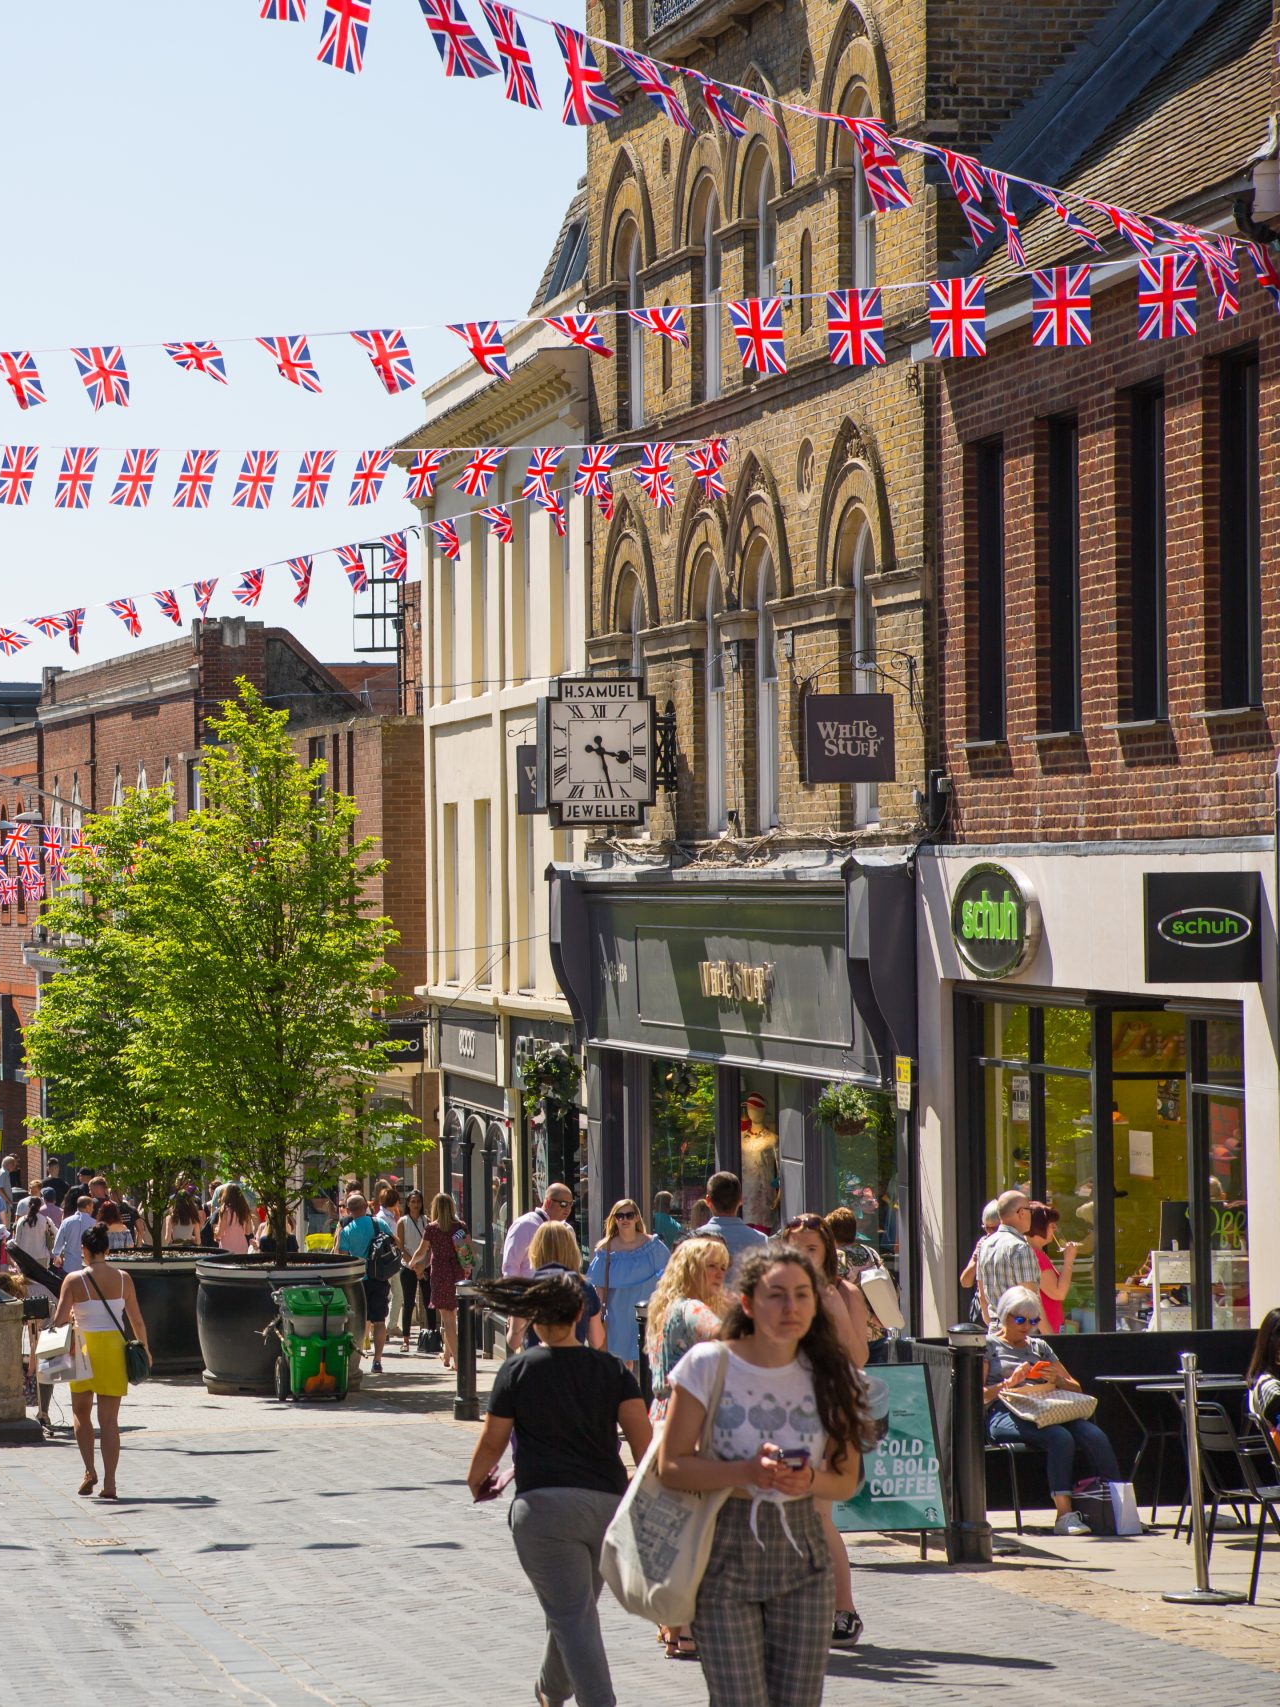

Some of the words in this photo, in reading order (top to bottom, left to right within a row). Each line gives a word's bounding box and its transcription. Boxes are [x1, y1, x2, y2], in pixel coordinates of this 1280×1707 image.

[564, 685, 634, 698] H.SAMUEL
[567, 804, 636, 818] JEWELLER
[962, 890, 1018, 940] schuh
[1172, 917, 1239, 936] schuh
[876, 1439, 924, 1457] COLD
[874, 1460, 887, 1476] &
[892, 1457, 940, 1476] BOLD
[871, 1476, 937, 1496] COFFEE
